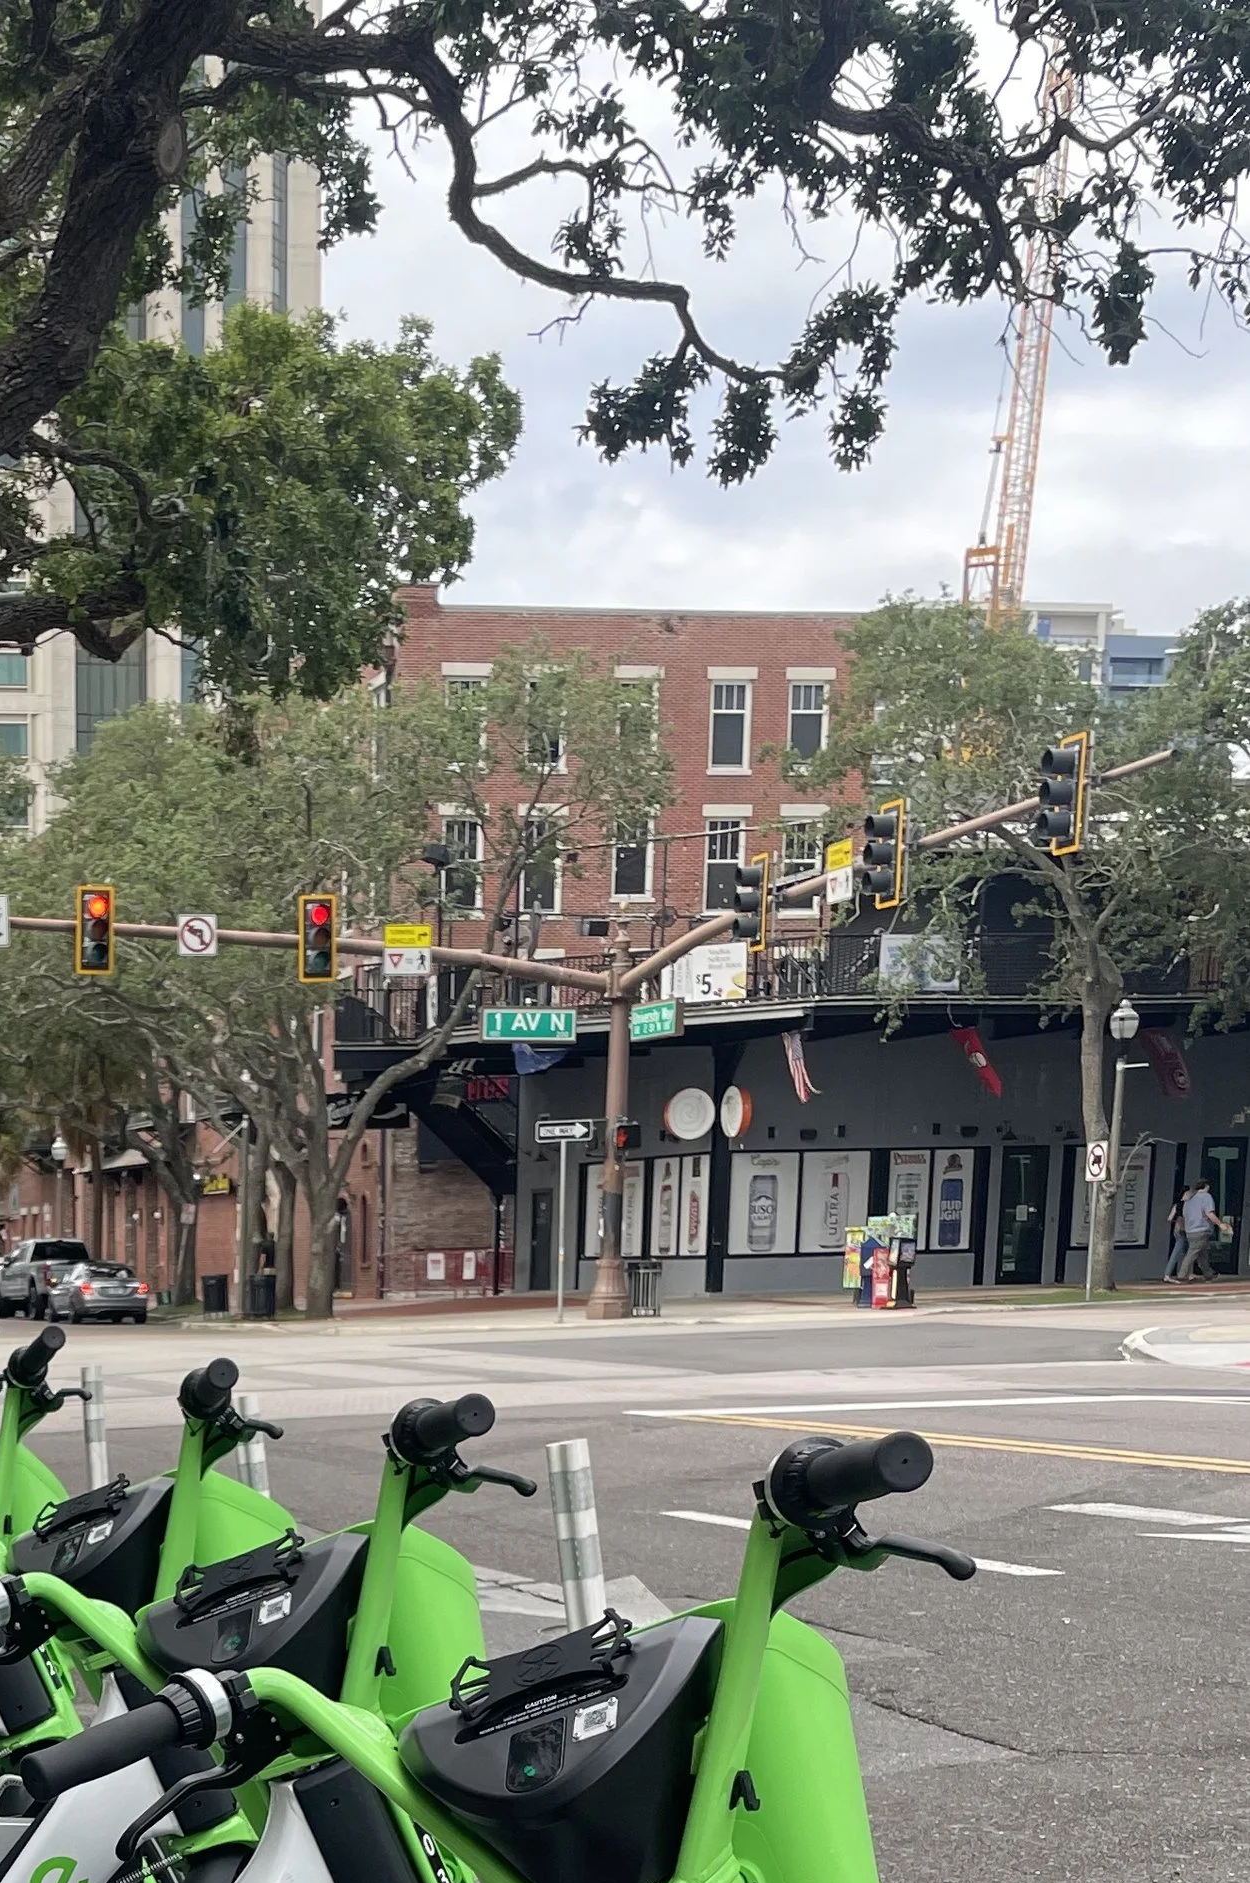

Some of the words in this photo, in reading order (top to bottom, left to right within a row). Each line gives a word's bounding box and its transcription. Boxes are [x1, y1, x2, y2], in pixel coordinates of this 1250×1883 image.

[695, 972, 712, 995] $5
[495, 1012, 502, 1031] 1
[511, 1012, 542, 1031] AV
[550, 1012, 566, 1032] N
[828, 1191, 840, 1236] ULTRA
[524, 1694, 557, 1710] CAUTION
